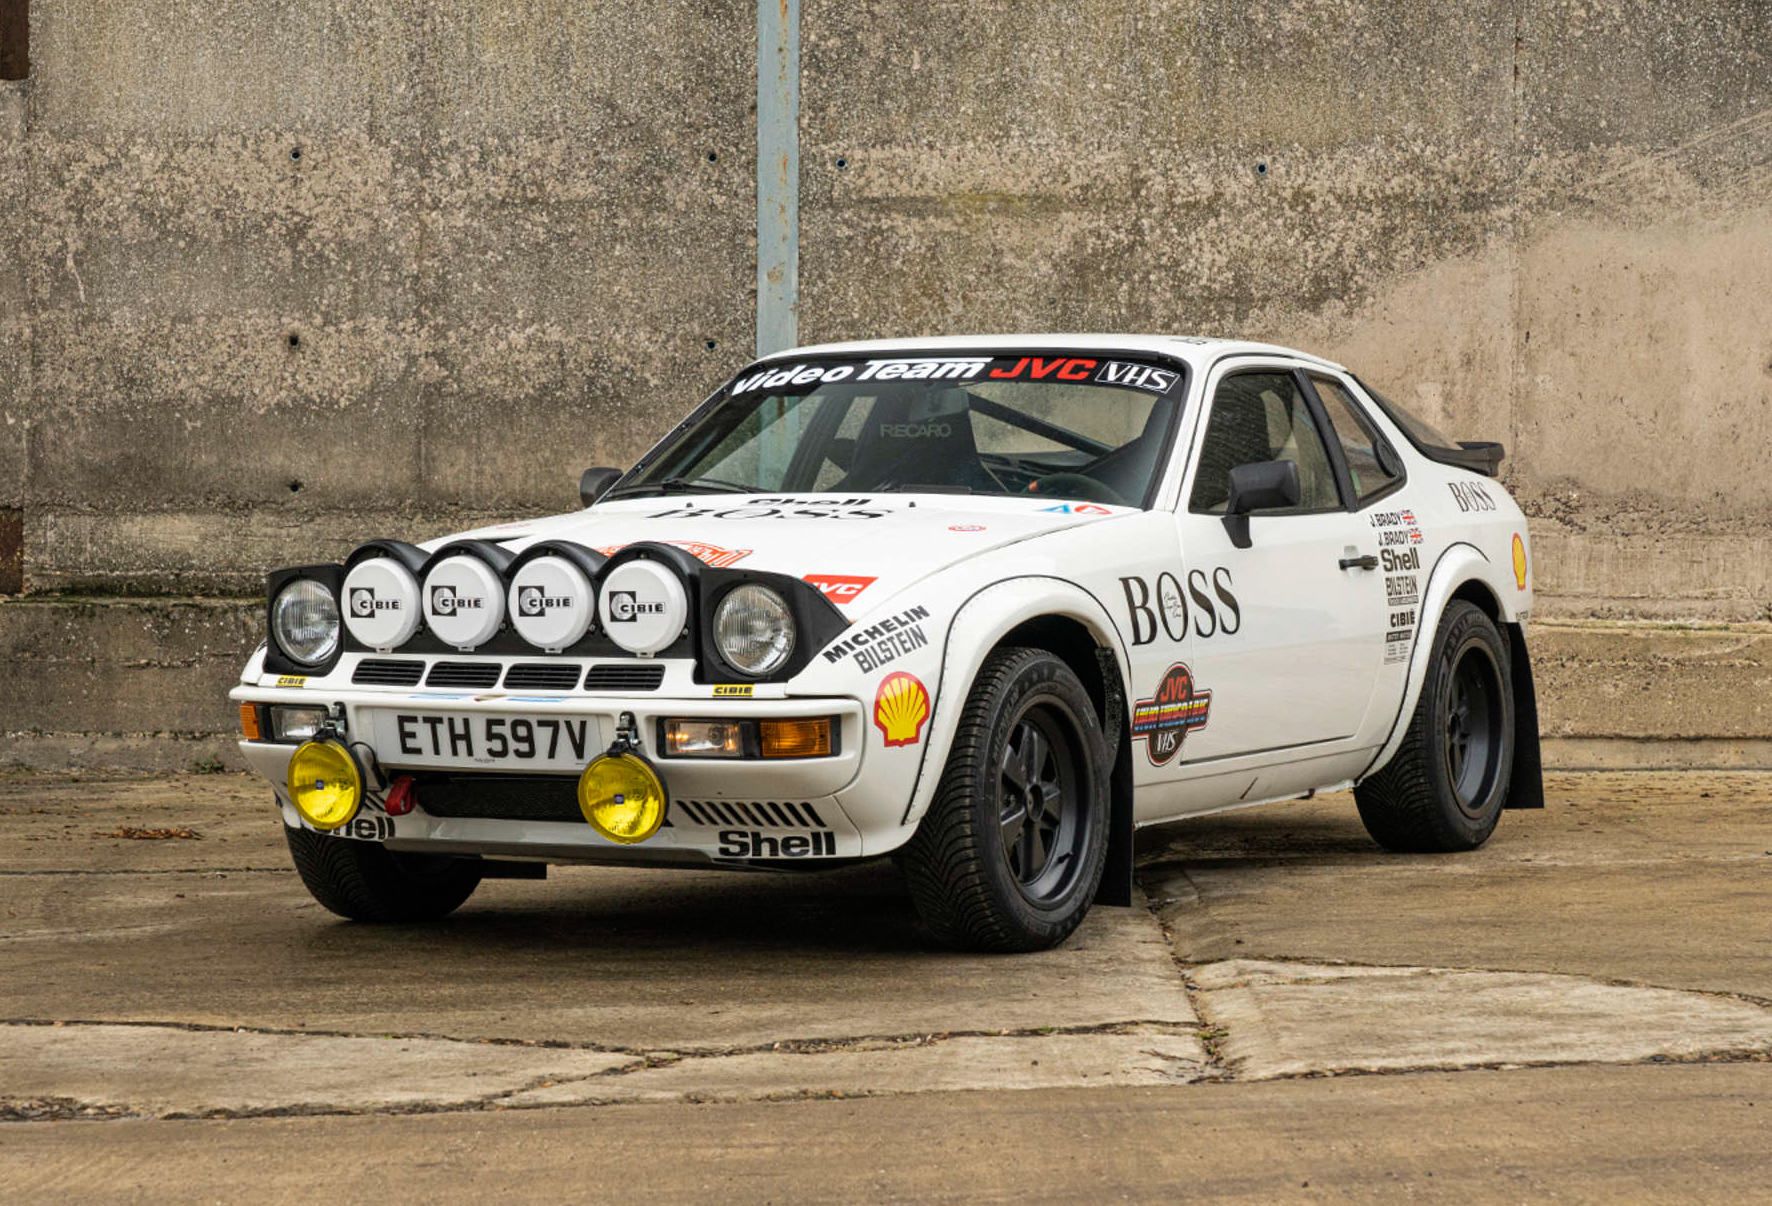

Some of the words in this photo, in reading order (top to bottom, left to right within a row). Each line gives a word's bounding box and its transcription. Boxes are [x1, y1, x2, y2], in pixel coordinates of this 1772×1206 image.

[732, 364, 855, 396] Video
[856, 357, 994, 381] Team
[989, 357, 1098, 380] JVC
[1107, 363, 1179, 390] VHS
[880, 423, 951, 438] RECARO
[1448, 481, 1496, 512] BOSS
[1380, 547, 1420, 572] Shell
[1118, 566, 1240, 646] BOSS
[822, 605, 930, 664] MICHELIN
[853, 624, 928, 674] BILSTEIN
[1160, 675, 1188, 702] JVC
[397, 715, 474, 757] ETH
[485, 718, 587, 760] 597V
[1155, 730, 1179, 752] VHS
[718, 830, 836, 857] Shell
